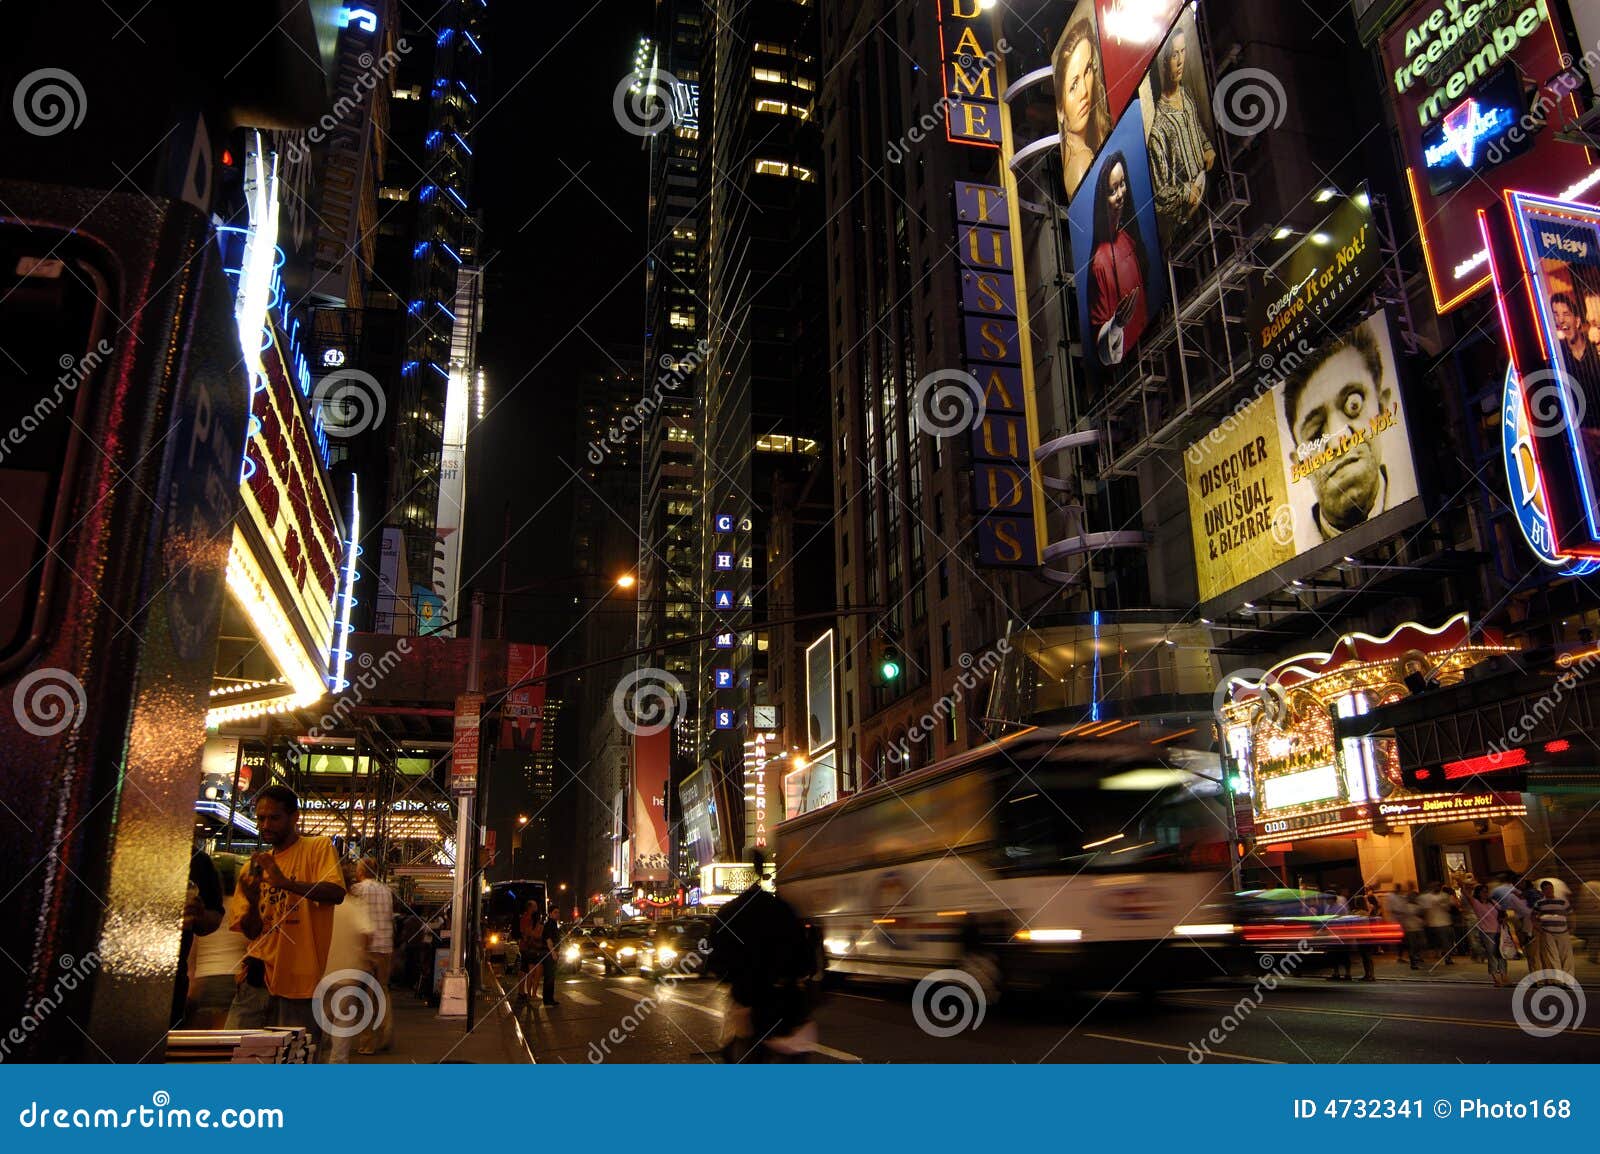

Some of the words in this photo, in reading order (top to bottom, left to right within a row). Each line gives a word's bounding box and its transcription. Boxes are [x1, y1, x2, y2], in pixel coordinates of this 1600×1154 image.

[1404, 8, 1446, 58] Are
[1260, 296, 1305, 349] Believe
[1304, 279, 1320, 305] It
[1319, 264, 1336, 290] or
[1335, 224, 1367, 274] Not!
[1276, 316, 1310, 353] TIMES
[1314, 266, 1361, 316] SQUARE
[1199, 435, 1268, 498] DISCOVER
[1290, 448, 1335, 484] Believe
[1336, 433, 1350, 457] It
[1349, 429, 1367, 450] or
[1368, 401, 1398, 440] Not!
[1203, 477, 1275, 537] UNUSUAL
[1208, 539, 1219, 561] &
[716, 515, 732, 726] CHAMPS
[755, 732, 767, 847] AMSTERDAM
[1422, 799, 1453, 812] Believe
[1453, 798, 1463, 809] It
[1463, 798, 1473, 808] or
[1473, 794, 1494, 807] Not!
[729, 871, 755, 881] MARY
